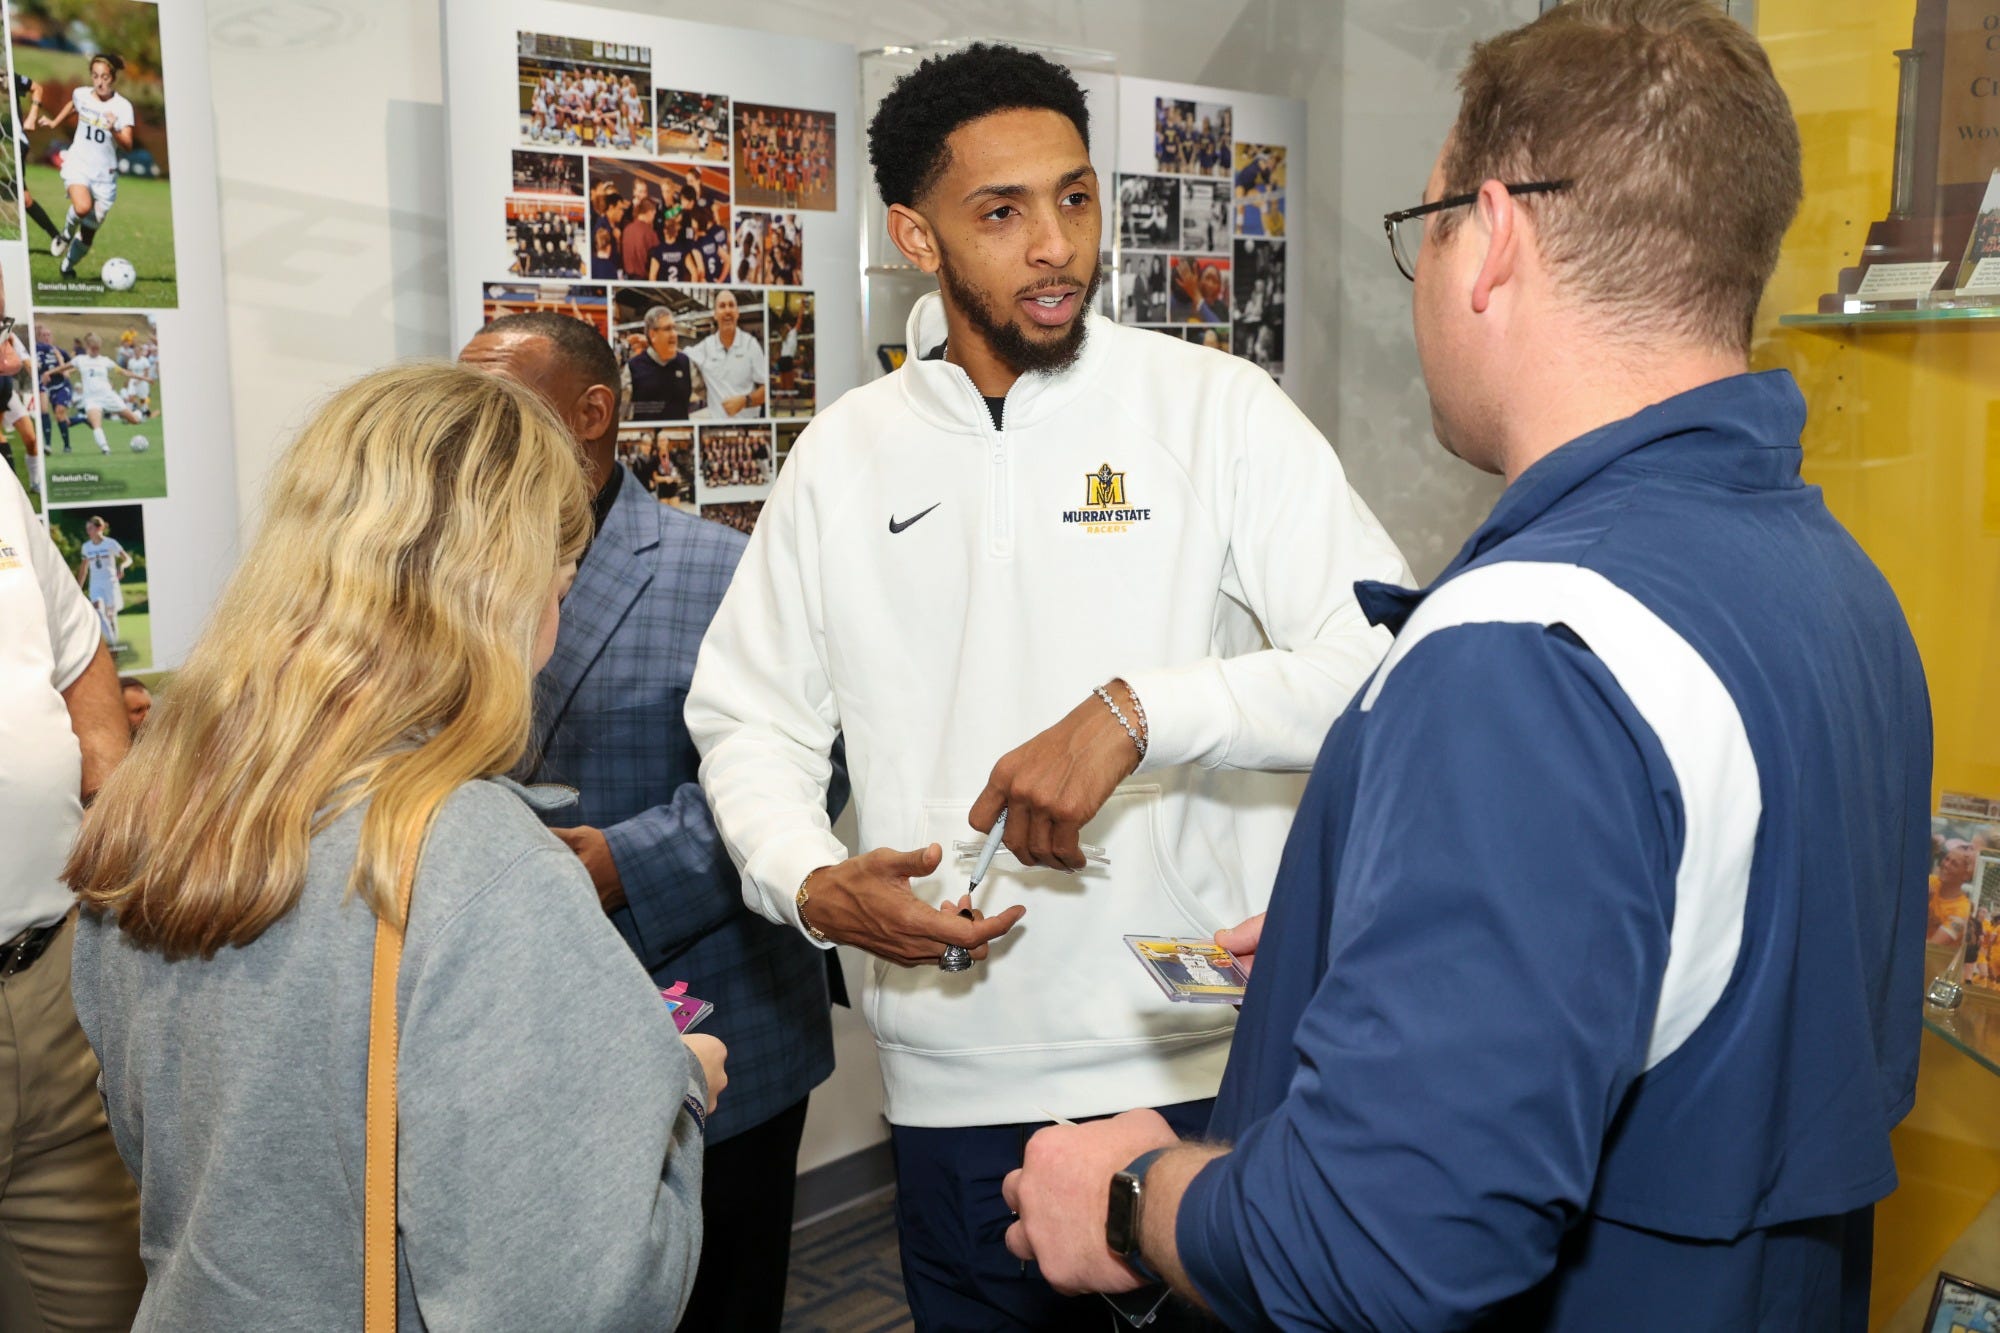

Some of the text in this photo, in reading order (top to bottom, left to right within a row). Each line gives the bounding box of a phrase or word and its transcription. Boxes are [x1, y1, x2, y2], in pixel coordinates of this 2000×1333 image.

[86, 125, 106, 143] 10
[68, 283, 105, 293] McMurray
[1063, 509, 1151, 523] MURRAY STATE
[1086, 525, 1128, 534] RACERS
